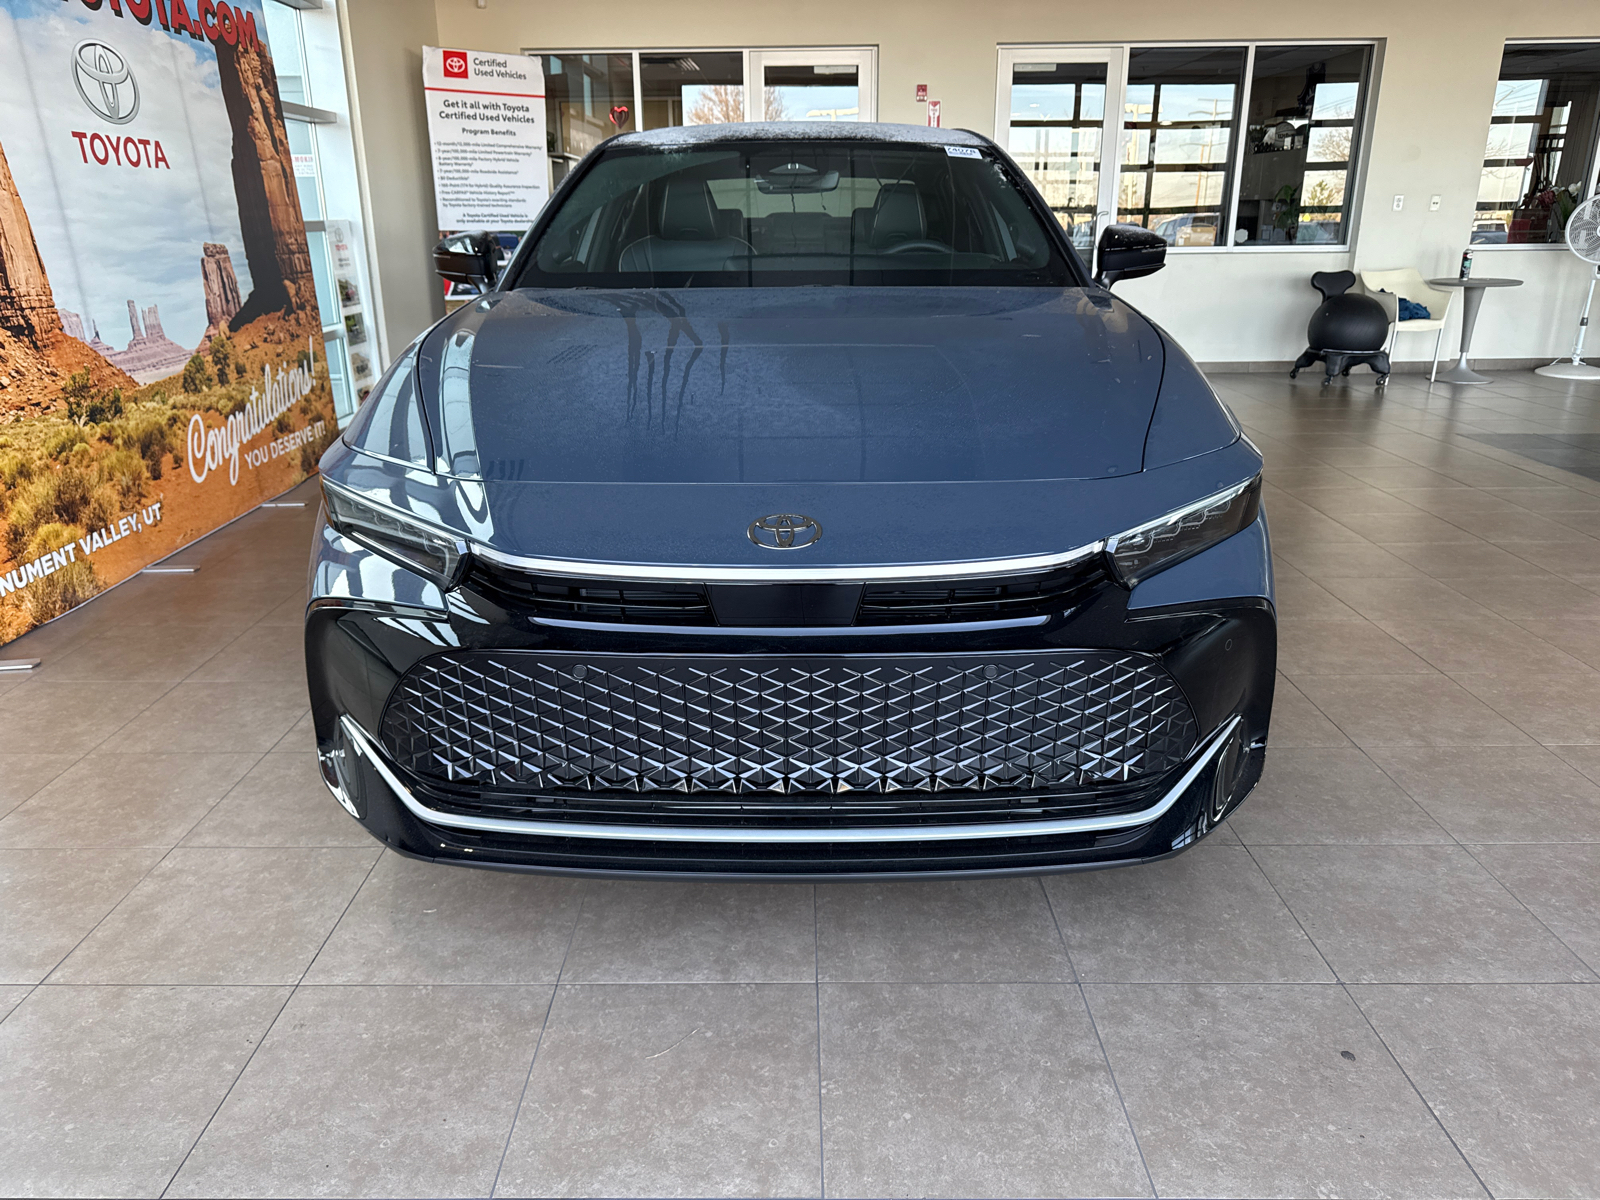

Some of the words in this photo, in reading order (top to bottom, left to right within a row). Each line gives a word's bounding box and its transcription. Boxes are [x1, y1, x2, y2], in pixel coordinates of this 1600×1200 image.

[473, 58, 507, 68] Certified
[474, 68, 494, 77] Used
[496, 70, 527, 80] Vehicles
[443, 100, 459, 108] Get
[461, 100, 468, 109] it
[470, 101, 480, 110] all
[482, 102, 500, 111] with
[502, 103, 530, 114] Toyota
[439, 110, 477, 121] Certified
[479, 112, 500, 122] Used
[501, 114, 535, 124] Vehicles
[462, 128, 489, 136] Program
[71, 130, 171, 170] TOYOTA
[187, 335, 316, 486] Congratulations!
[244, 445, 269, 470] YOU
[270, 424, 314, 459] DESERVE
[313, 420, 326, 438] IT!
[0, 542, 76, 597] NUMENT
[79, 513, 142, 556] VALLEY,
[142, 502, 162, 525] UT
